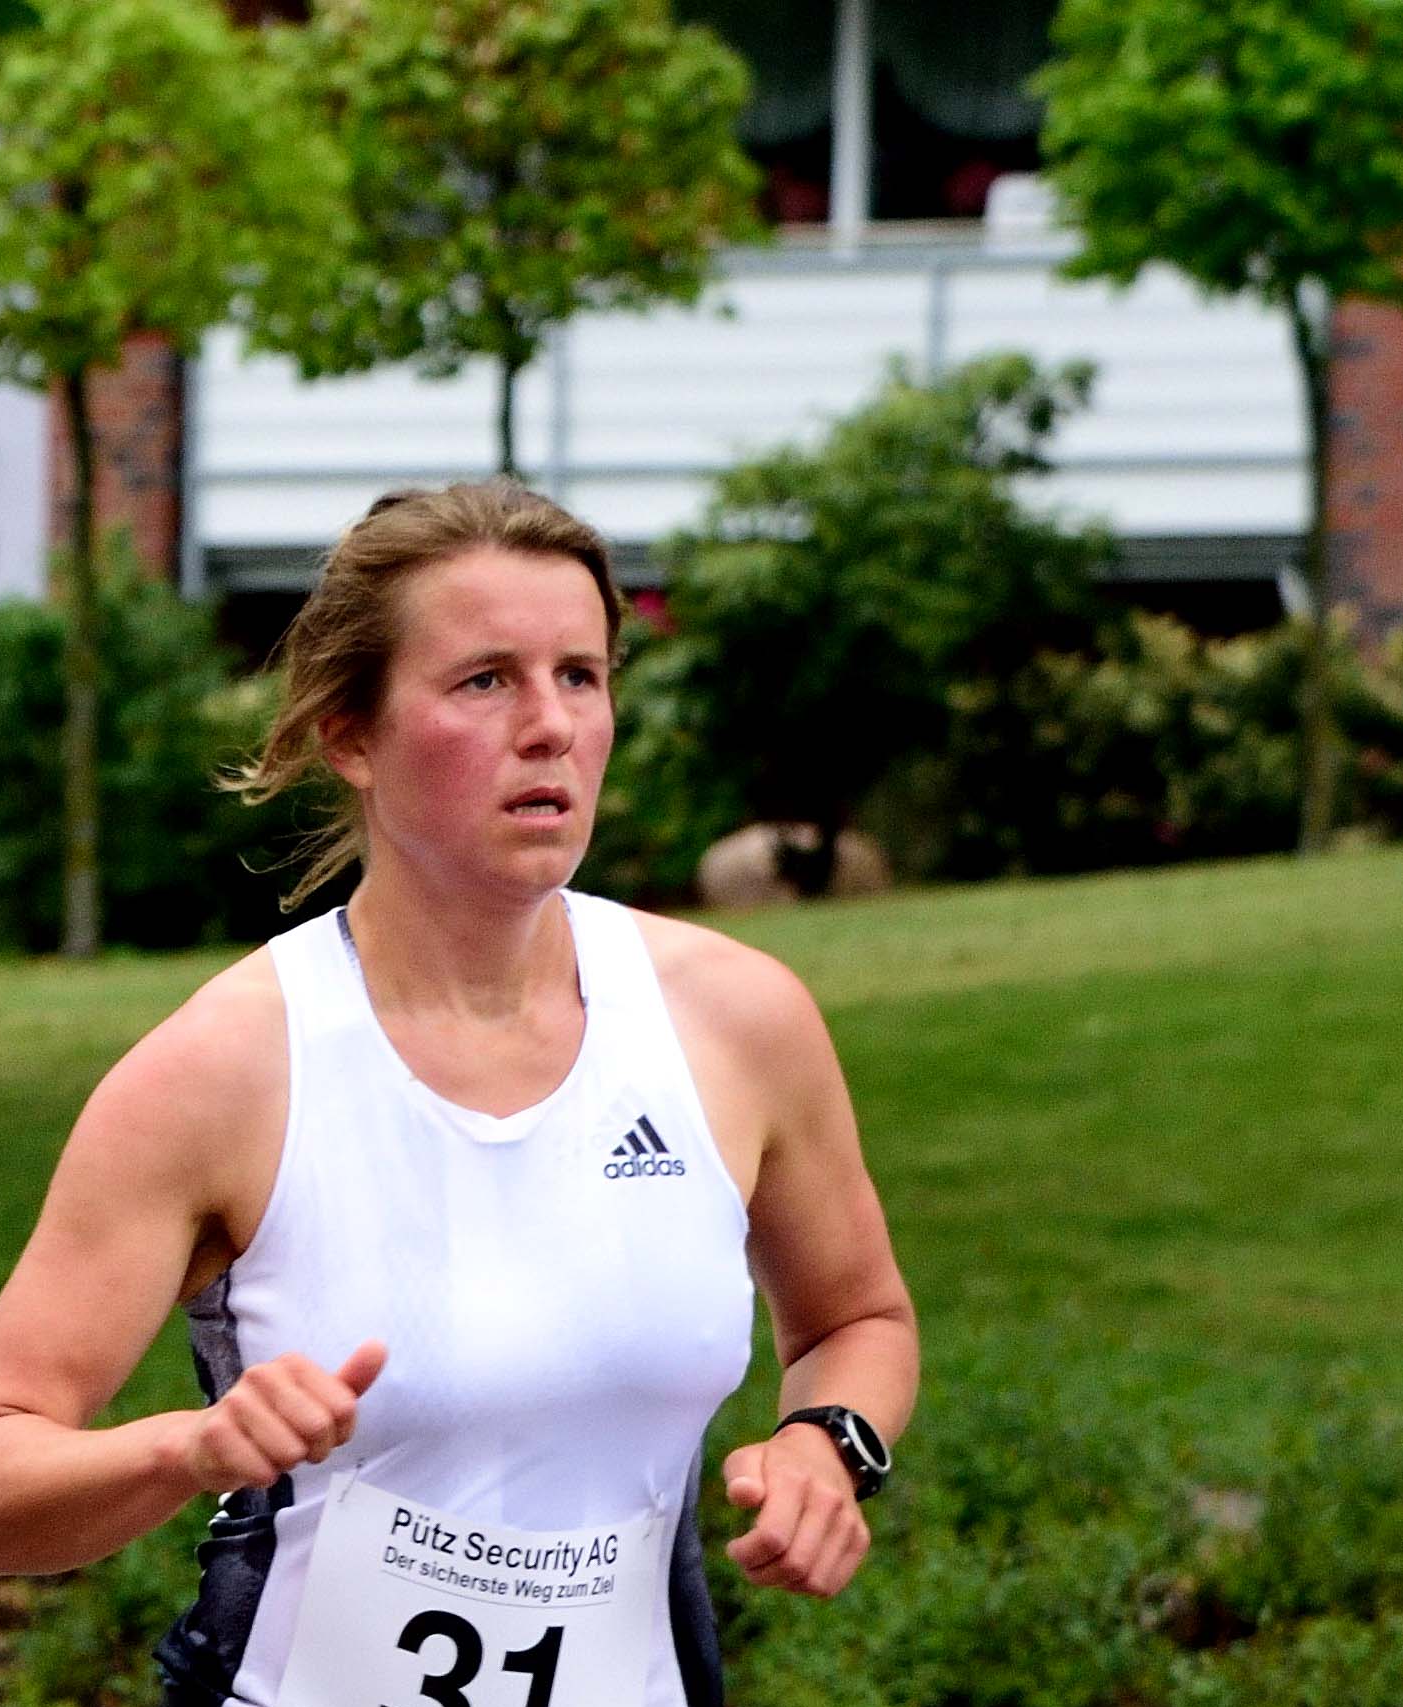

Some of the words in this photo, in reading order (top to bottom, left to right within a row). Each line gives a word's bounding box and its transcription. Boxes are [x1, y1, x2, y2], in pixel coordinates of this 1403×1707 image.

[603, 1157, 686, 1179] adidas
[391, 1507, 458, 1555] Pütz
[463, 1532, 584, 1578] Security
[586, 1534, 618, 1568] AG
[382, 1545, 415, 1571] Der
[418, 1561, 509, 1596] sicherste
[514, 1579, 553, 1603] Weg
[557, 1581, 588, 1598] zum
[593, 1574, 615, 1596] Ziel
